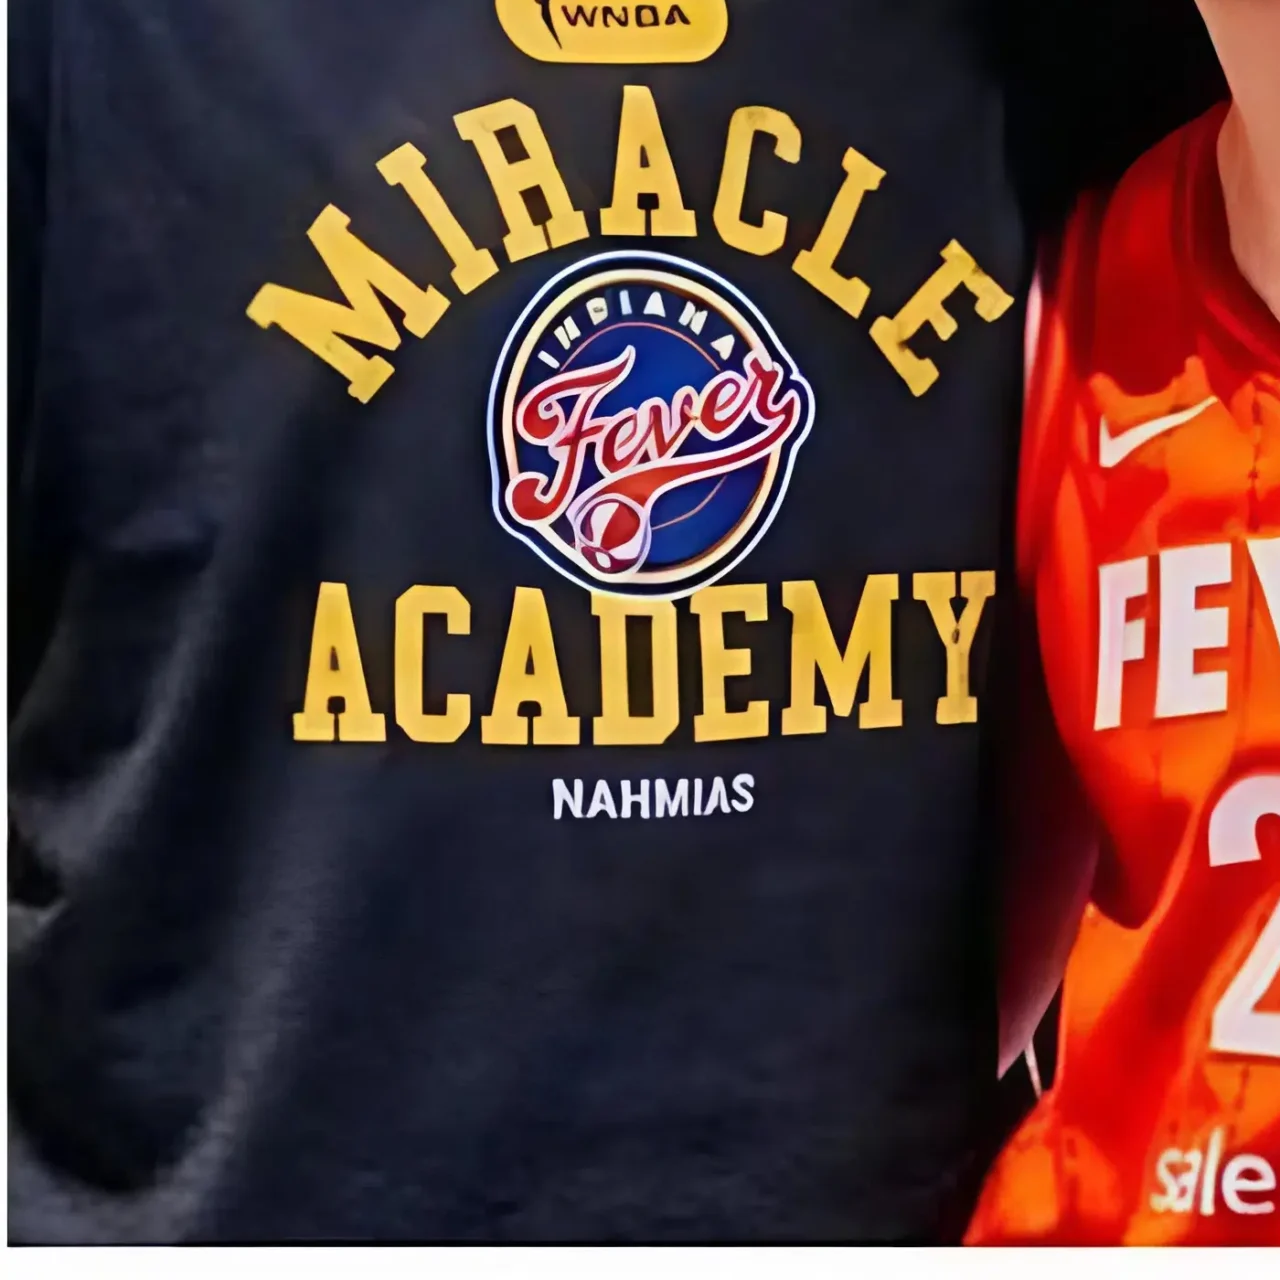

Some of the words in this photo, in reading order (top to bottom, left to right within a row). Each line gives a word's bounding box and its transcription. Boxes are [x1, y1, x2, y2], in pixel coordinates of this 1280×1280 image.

[247, 85, 1015, 404] MIRACLE
[505, 344, 801, 522] Fever
[293, 571, 996, 746] ACADEMY
[552, 773, 755, 820] NAHMIAS
